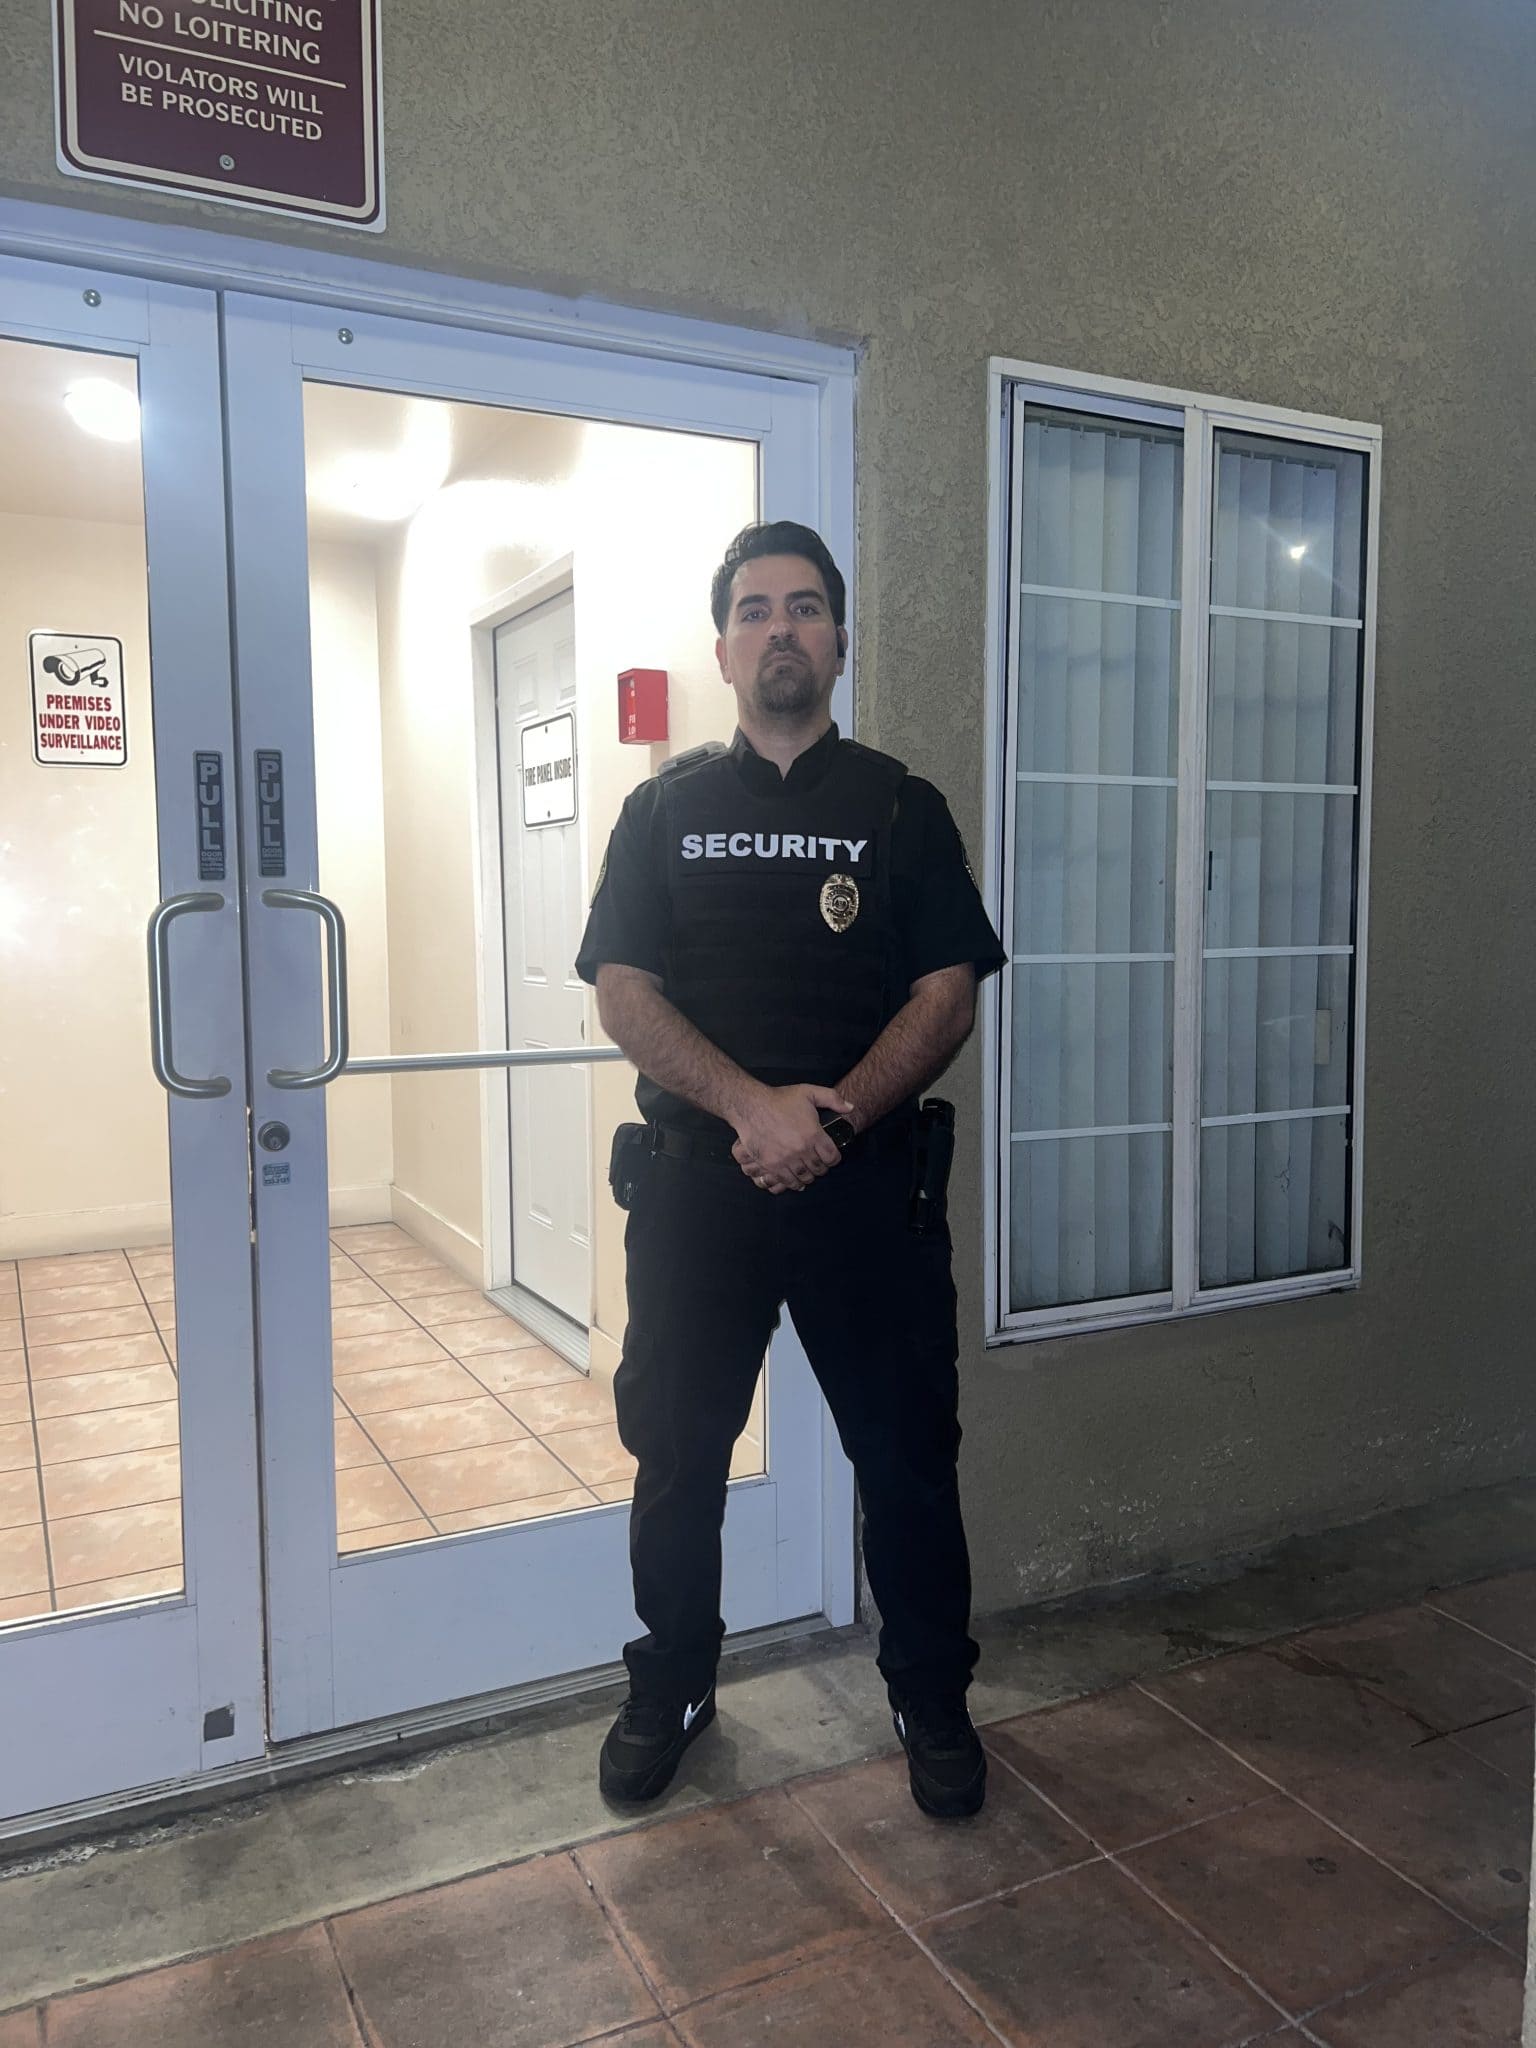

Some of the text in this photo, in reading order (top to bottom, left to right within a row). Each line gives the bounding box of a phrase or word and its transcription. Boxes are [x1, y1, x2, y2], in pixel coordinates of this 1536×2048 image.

[119, 0, 321, 65] NO LOITERING
[118, 53, 323, 115] VIOLATORS WILL
[121, 82, 322, 141] BE PROSECUTED
[39, 713, 121, 732] UNDER VIDEO
[46, 694, 112, 712] PREMISES
[40, 733, 122, 751] SURVEILLANCE
[525, 757, 571, 787] FIRE PANEL INSIDE
[199, 761, 221, 850] PULL
[260, 760, 281, 847] PULL
[681, 832, 868, 863] SECURITY
